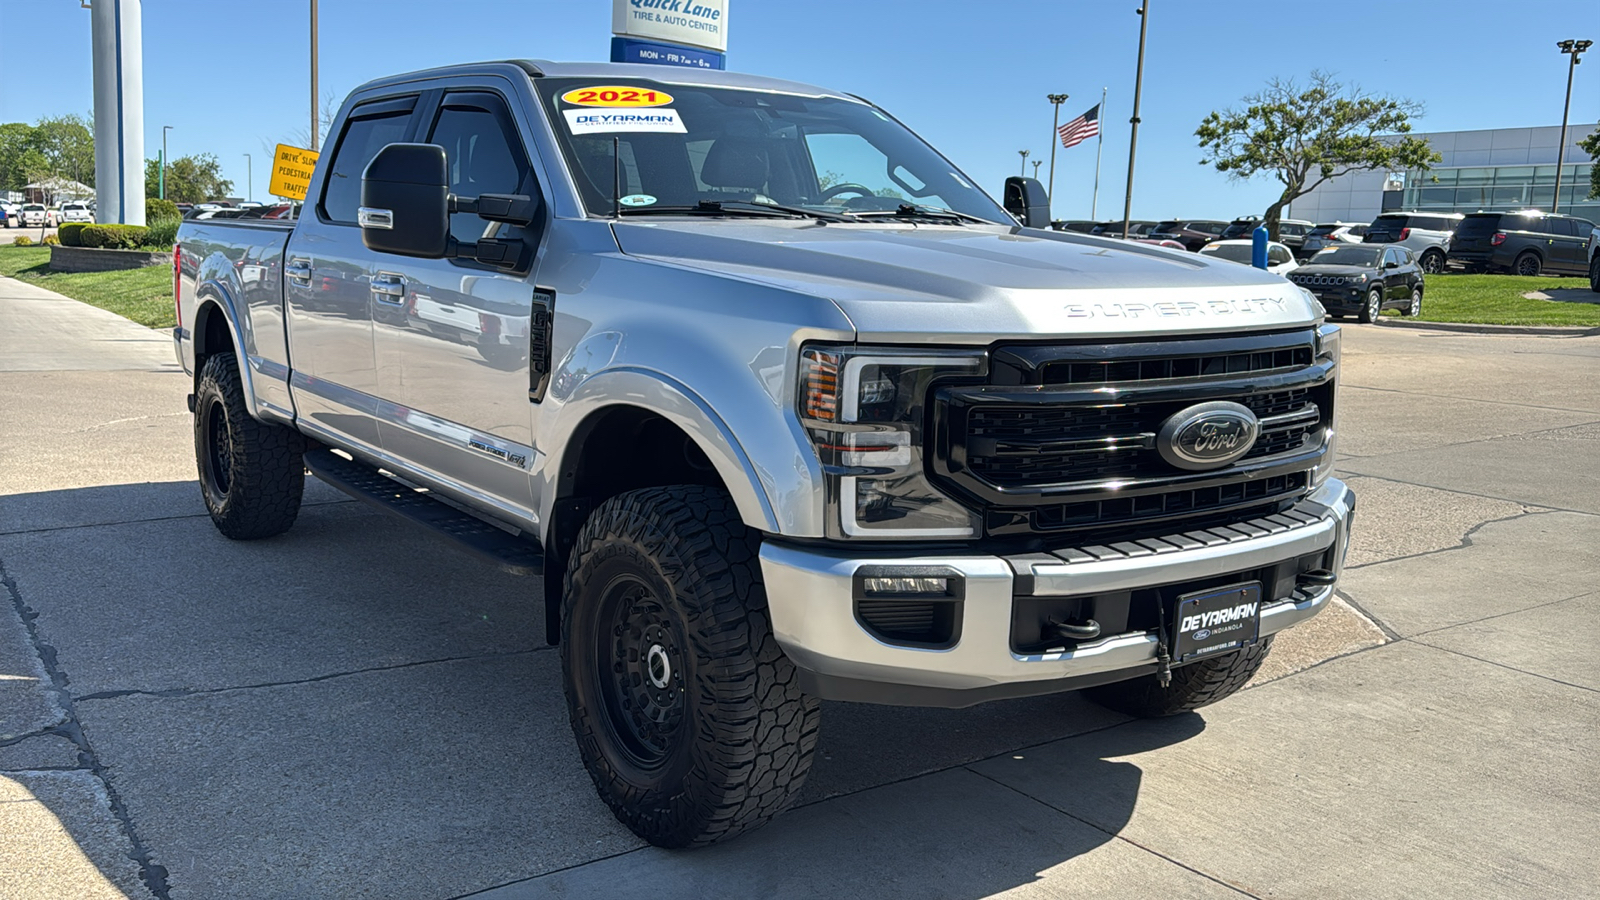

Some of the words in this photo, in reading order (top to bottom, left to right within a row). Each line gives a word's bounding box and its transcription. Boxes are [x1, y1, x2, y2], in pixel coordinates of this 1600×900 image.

[683, 0, 720, 20] Lane
[633, 10, 653, 21] TIRE
[655, 14, 661, 22] &
[663, 15, 687, 26] AUTO
[688, 19, 718, 33] CENTER
[639, 50, 658, 59] MON
[667, 54, 678, 62] FRI
[577, 91, 656, 103] 2021
[576, 115, 673, 123] DEYARMAN
[281, 152, 299, 163] DRIVE
[279, 166, 313, 180] PEDESTRIA
[1063, 301, 1206, 319] SUPER
[1207, 297, 1288, 314] DUTY
[1194, 421, 1241, 452] Ford
[1180, 602, 1257, 633] DEYARMAN
[1212, 623, 1243, 635] INDIANOLA
